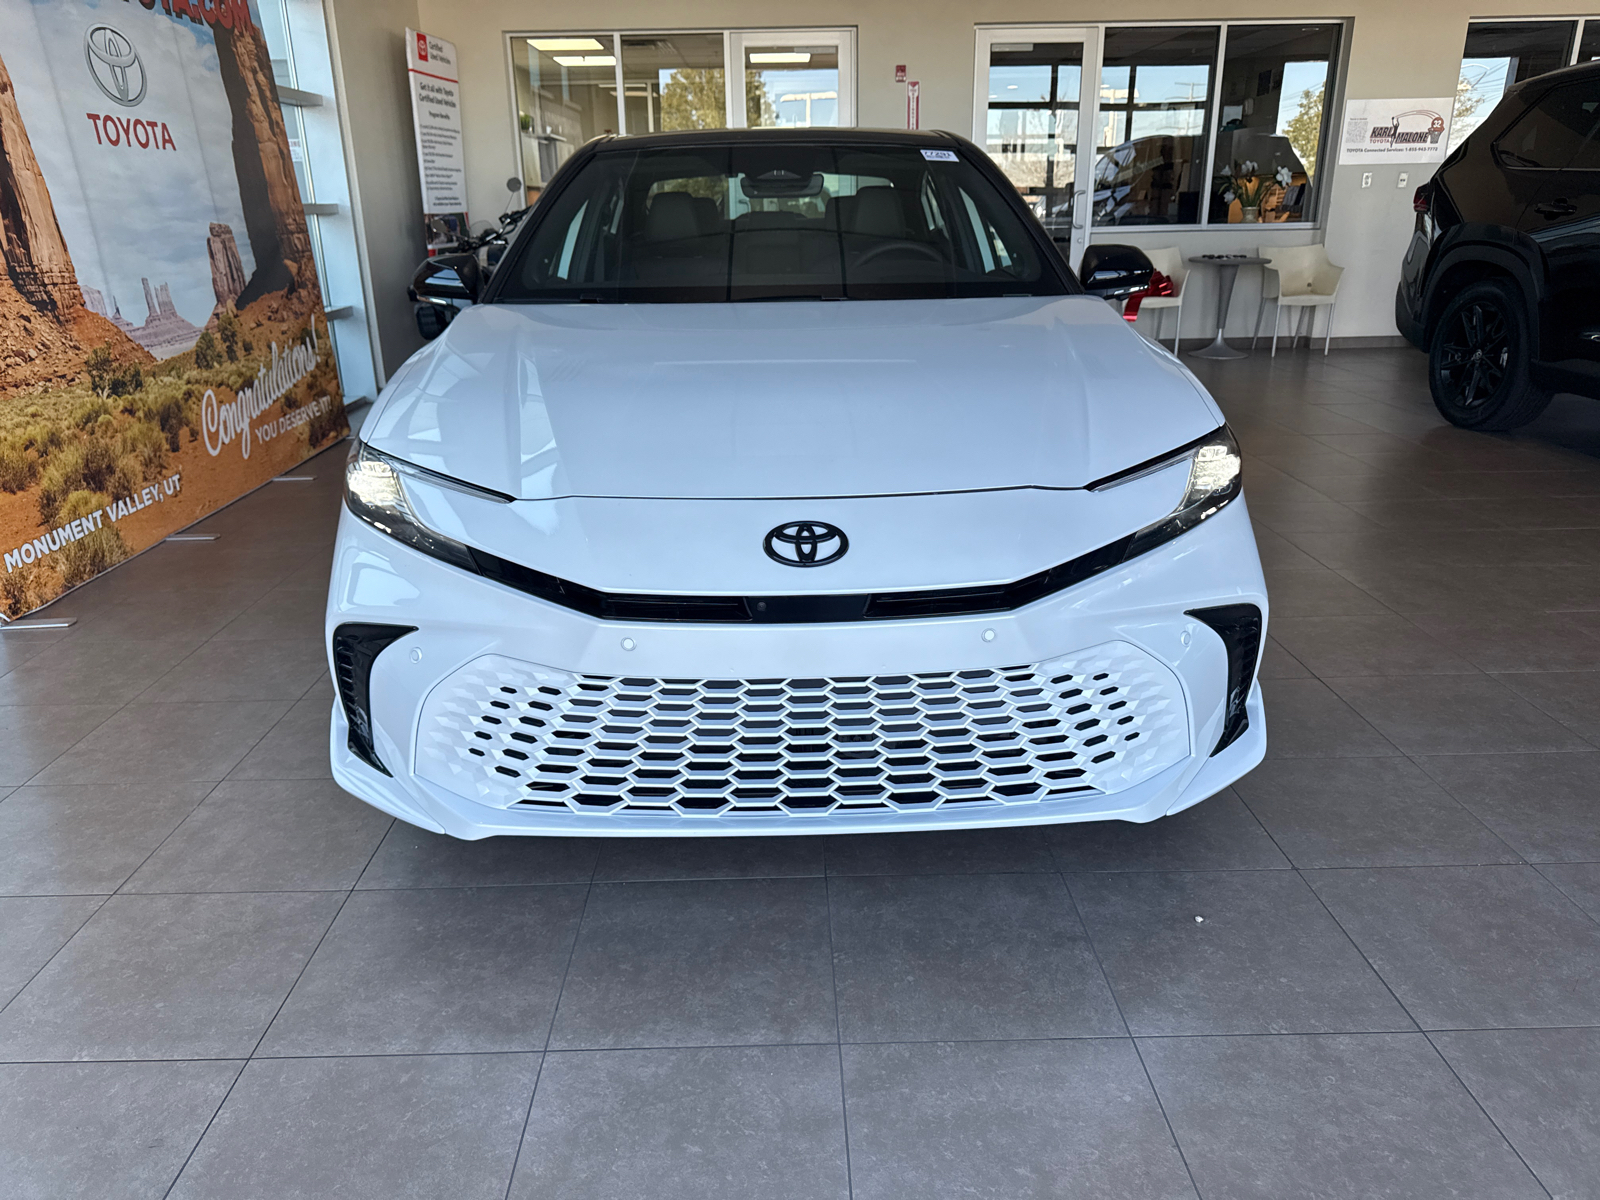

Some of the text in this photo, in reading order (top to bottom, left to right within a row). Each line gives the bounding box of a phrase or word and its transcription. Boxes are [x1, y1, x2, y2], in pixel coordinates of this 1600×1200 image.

[86, 112, 177, 151] TOYOTA
[1370, 127, 1430, 144] KARL MALONE
[202, 313, 321, 459] Congratulations!
[255, 421, 278, 444] YOU
[279, 401, 321, 434] DESERVE
[3, 474, 181, 573] MONUMENT VALLEY, UT
